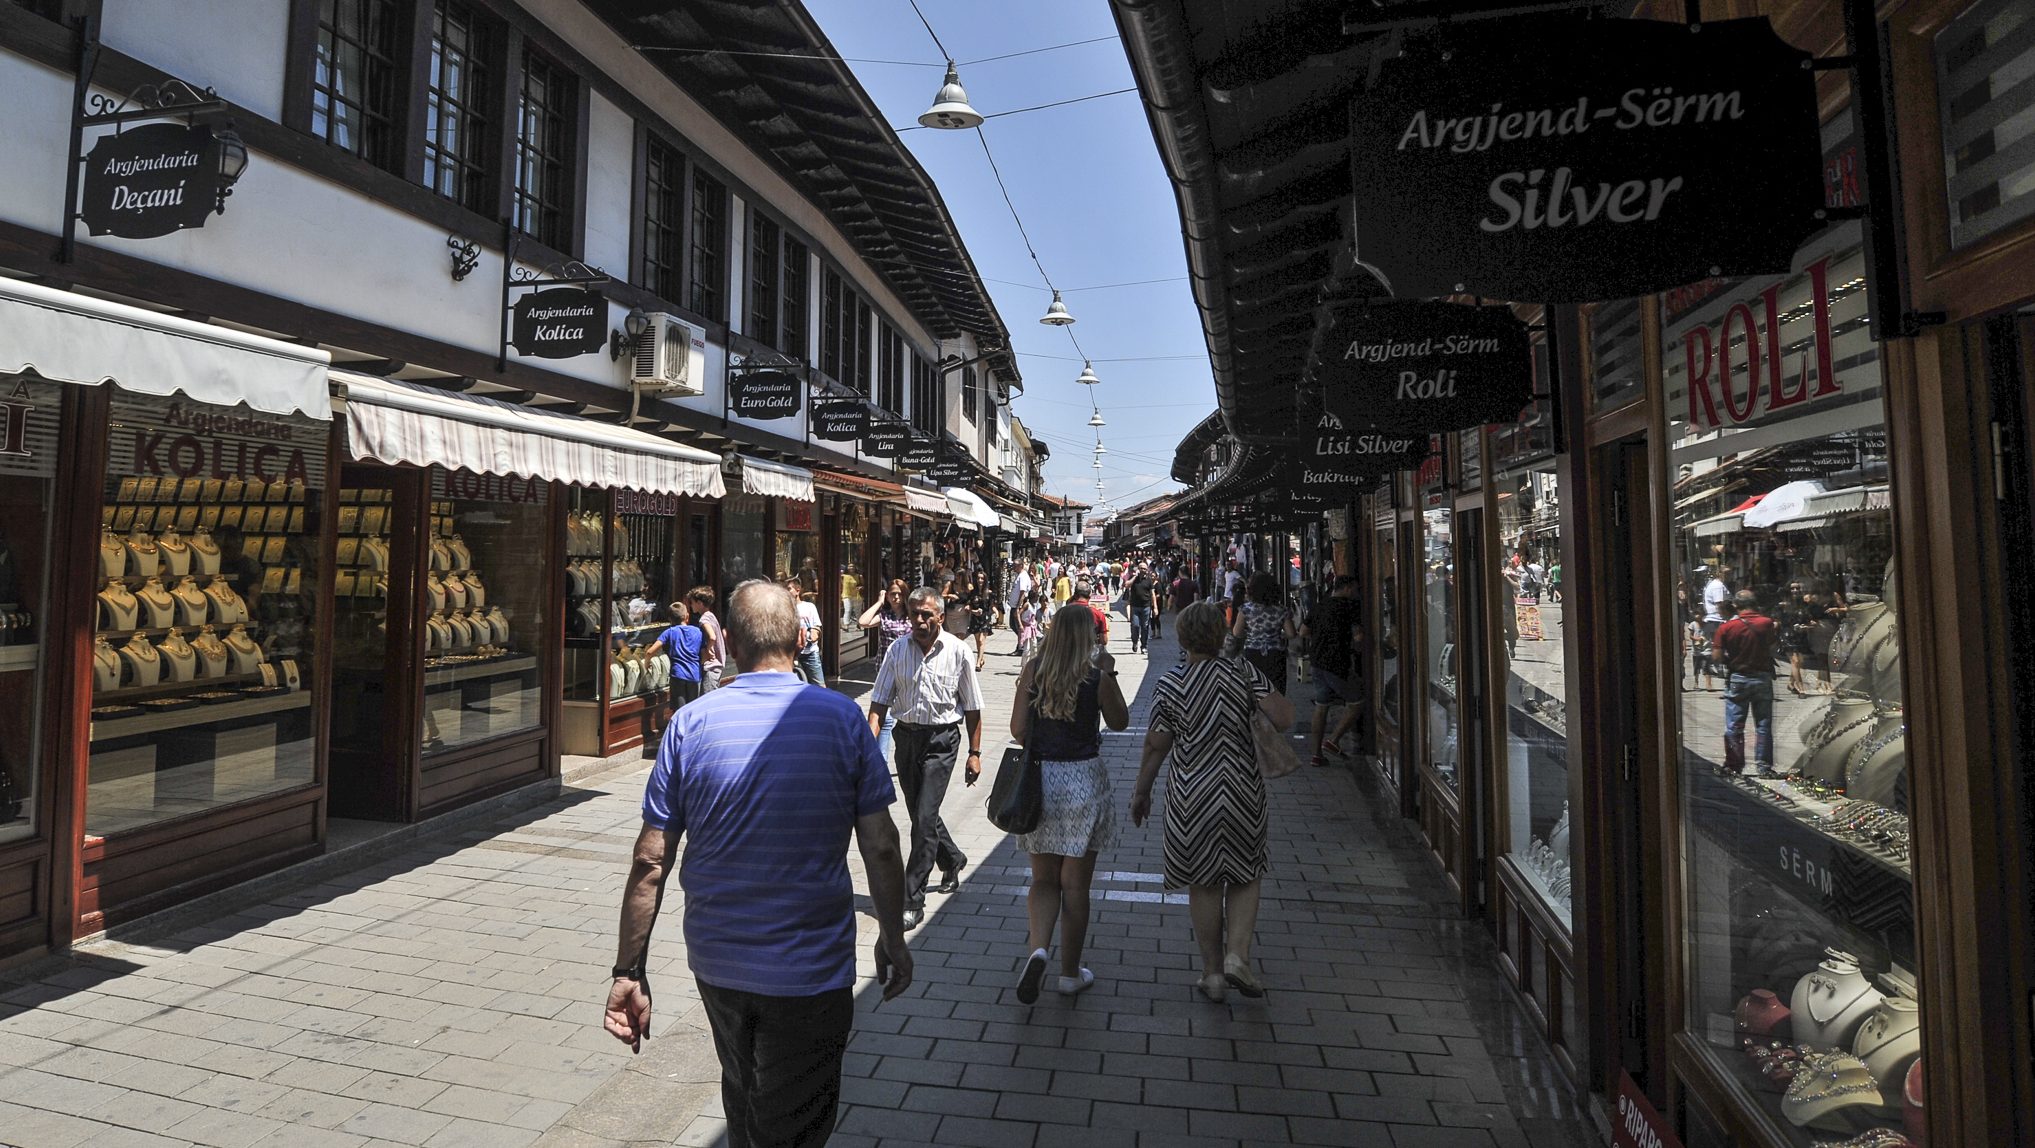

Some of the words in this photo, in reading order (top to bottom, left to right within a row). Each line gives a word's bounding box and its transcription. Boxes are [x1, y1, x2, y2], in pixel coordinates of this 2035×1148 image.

[1397, 86, 1745, 153] Argjend-Sërm
[104, 150, 198, 176] Argjendaria
[111, 180, 185, 214] Deçani
[1479, 166, 1684, 233] Silver
[526, 305, 594, 320] Argjendaria
[534, 324, 584, 341] Kolica
[1682, 256, 1843, 434] ROLI
[1344, 335, 1501, 363] Argjend-Sërm
[742, 383, 791, 394] Argjendaria
[1396, 369, 1458, 399] Roli
[164, 402, 292, 440] Argjendaria
[821, 411, 862, 420] Argjendaria
[826, 422, 856, 432] Kolica
[877, 441, 894, 450] Lira
[1316, 435, 1351, 455] Lisi
[1355, 434, 1414, 454] Silver
[134, 431, 308, 489] KOLICA
[444, 474, 538, 503] KOLICA
[614, 488, 678, 516] EUROGOLD
[1780, 846, 1833, 897] SËRM
